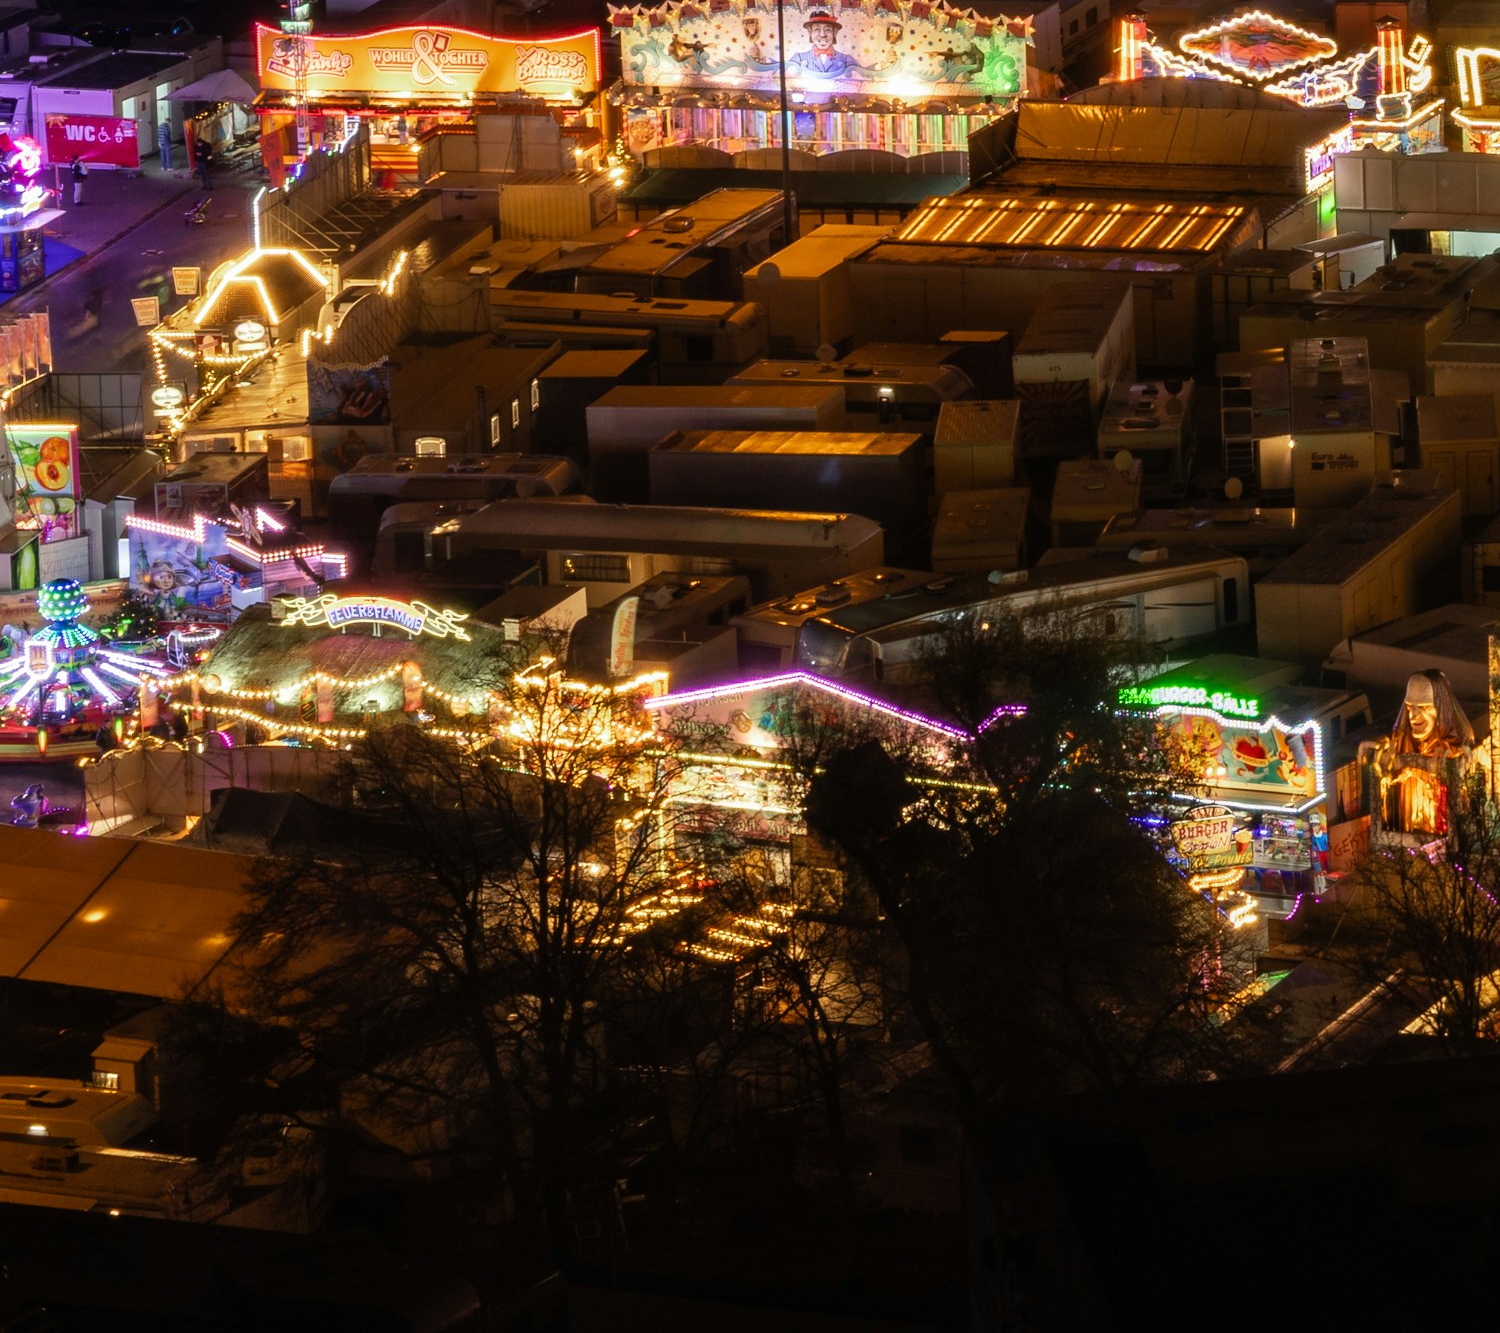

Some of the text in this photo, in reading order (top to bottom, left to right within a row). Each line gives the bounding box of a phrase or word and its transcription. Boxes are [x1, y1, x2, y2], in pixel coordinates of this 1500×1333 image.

[371, 49, 407, 65] WOHLD
[430, 48, 482, 66] TOCHTER
[65, 124, 96, 142] WC
[328, 603, 427, 636] FEUER&FLAMME
[1179, 823, 1229, 841] BURGER
